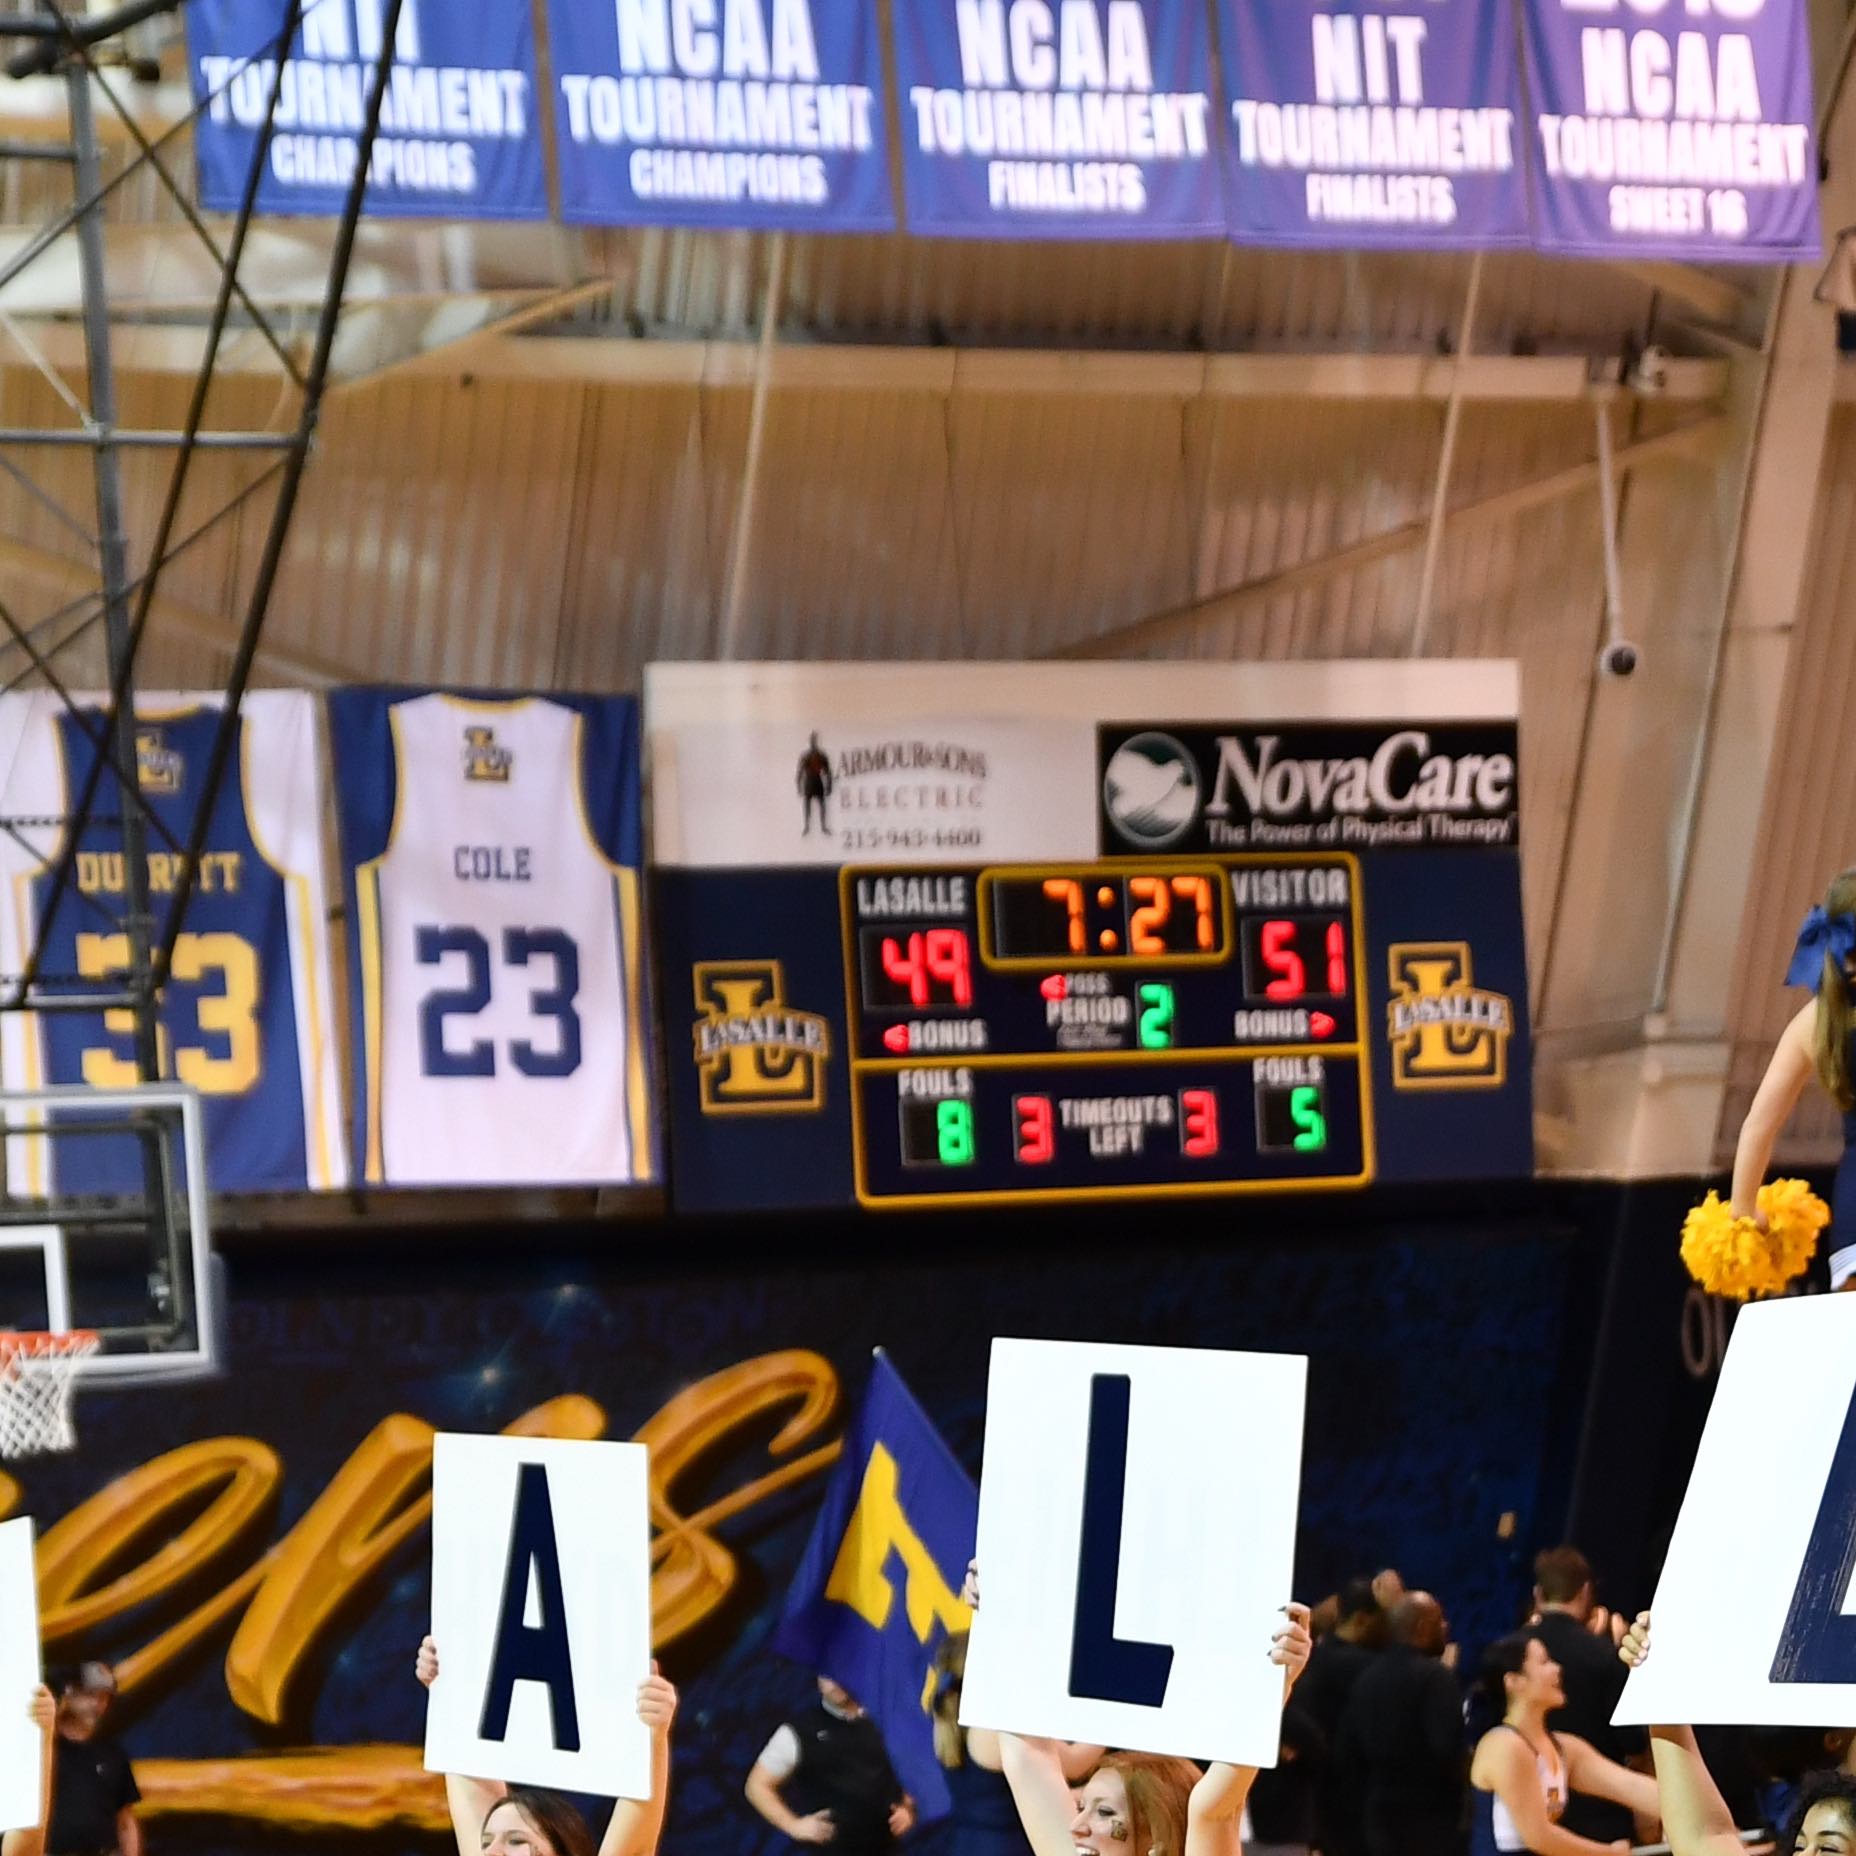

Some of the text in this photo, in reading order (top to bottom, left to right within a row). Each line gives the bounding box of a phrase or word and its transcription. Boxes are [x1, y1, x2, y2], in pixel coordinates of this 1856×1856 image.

[616, 0, 820, 78] NCAA
[956, 0, 1154, 92] NCAA
[1312, 12, 1428, 106] NIT
[1581, 26, 1763, 122] NCAA
[560, 74, 874, 152] TOURNAMENT
[910, 84, 1210, 160] TOURNAMENT
[1232, 98, 1514, 172] TOURNAMENT
[628, 148, 830, 204] CHAMPIONS
[1538, 112, 1808, 186] TOURNAMENT
[988, 160, 1146, 214] FINALISTS
[1306, 172, 1458, 224] FINALISTS
[1609, 184, 1749, 241] SWEET 16
[839, 784, 984, 810] ELECTRIC
[1204, 730, 1516, 816] NovaCare
[453, 845, 533, 882] COLE
[1205, 812, 1510, 849] The Power of Physical Therapy
[856, 876, 968, 916] LASALLE
[1042, 875, 1214, 955] 7:27
[1231, 867, 1350, 909] VISITOR
[881, 927, 974, 1010] 49
[1261, 920, 1346, 1004] 51
[415, 925, 582, 1078] 23
[907, 1017, 987, 1050] BONUS
[1046, 995, 1130, 1028] PERIOD
[1138, 983, 1176, 1051] 2
[1233, 1007, 1310, 1040] BONUS
[897, 1067, 973, 1098] FOULS
[1251, 1054, 1326, 1084] FOULS
[936, 1100, 974, 1166] 8
[1015, 1096, 1054, 1164] 3
[1057, 1094, 1174, 1128] TIMEOUTS
[1088, 1126, 1144, 1156] LEFT
[1181, 1089, 1219, 1156] 3
[1289, 1086, 1328, 1152] 5
[477, 1462, 582, 1753] A
[1068, 1372, 1176, 1709] L
